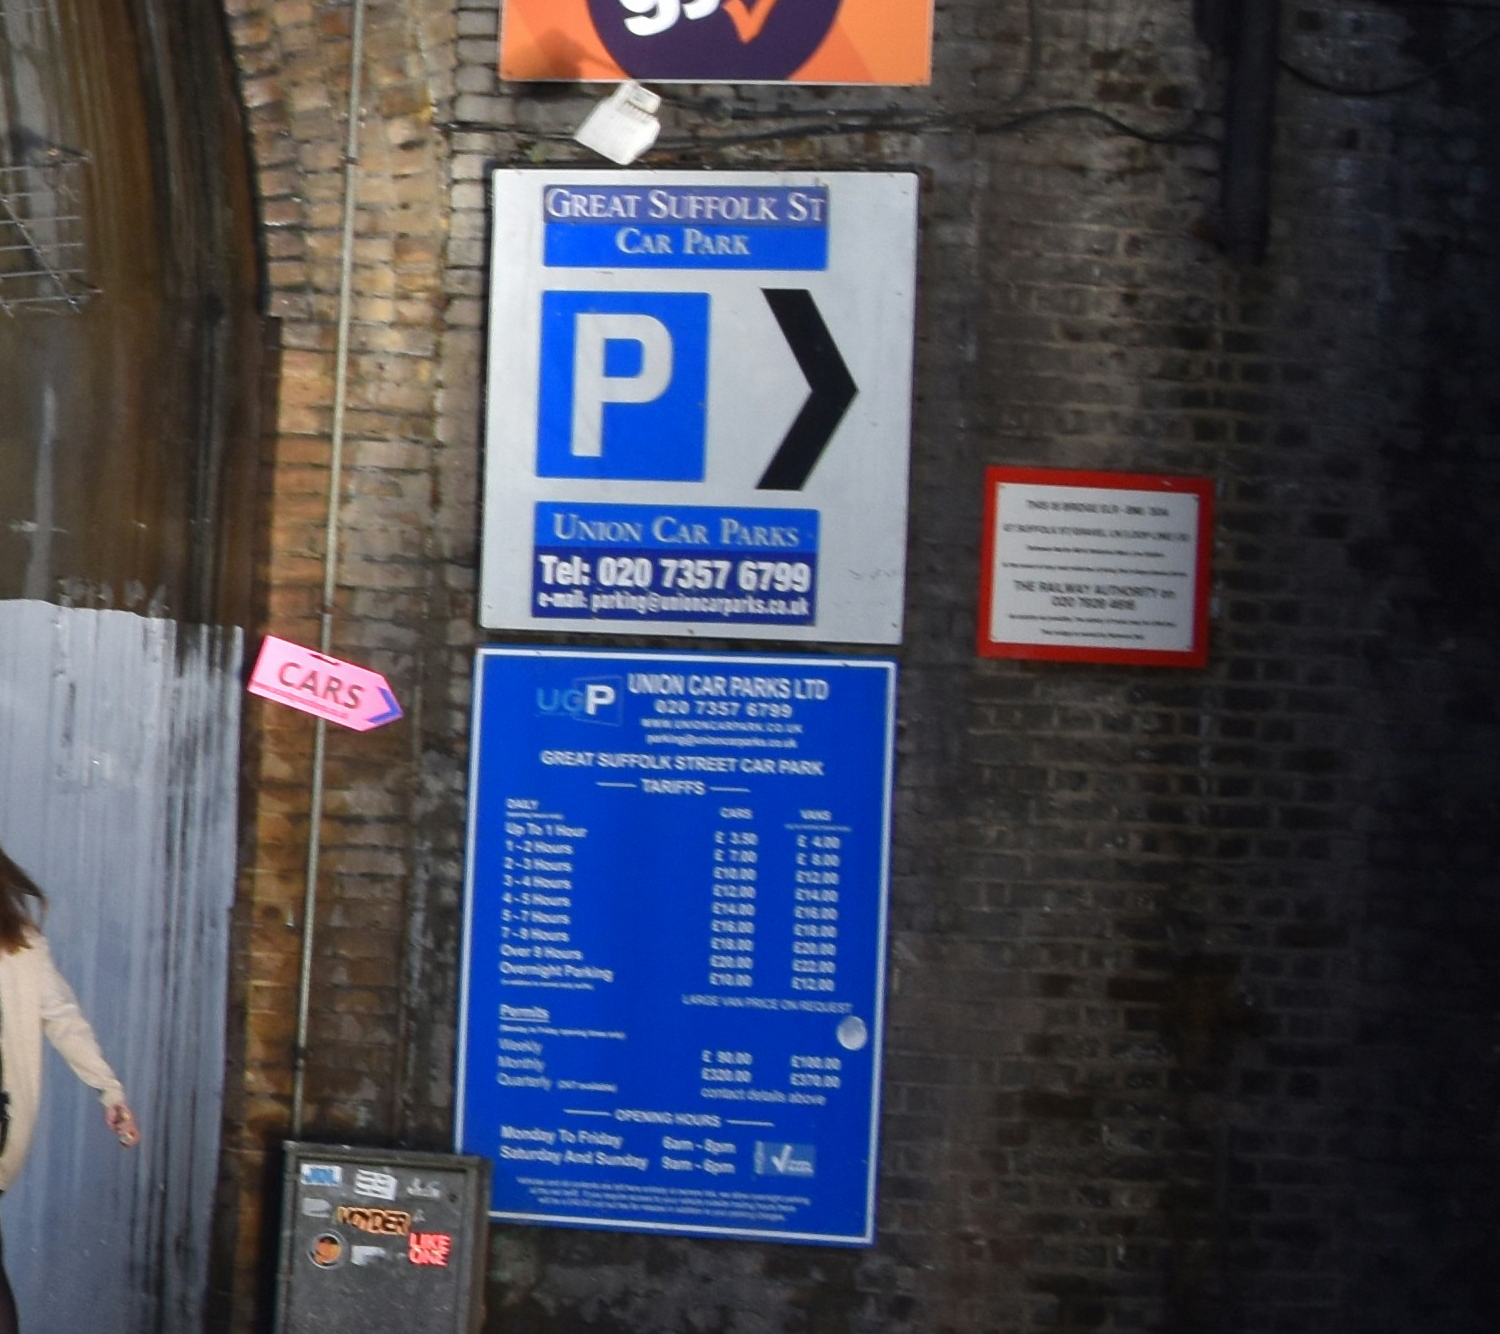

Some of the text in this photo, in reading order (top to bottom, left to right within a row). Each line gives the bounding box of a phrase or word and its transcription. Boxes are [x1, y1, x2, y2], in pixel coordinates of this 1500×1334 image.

[545, 188, 827, 222] GREAT SUFFOLK ST
[615, 227, 750, 255] CAR PARK
[571, 312, 673, 458] P
[552, 512, 800, 548] UNION CAR PARKS
[538, 554, 811, 593] Tel: 020 7357 6799
[1039, 581, 1090, 594] RAILWAY
[1094, 584, 1158, 598] AUTHORITY
[591, 591, 809, 616] parking@unioncarparks.co.uk
[277, 661, 365, 710] CARS
[628, 673, 685, 696] UNION
[689, 674, 726, 697] CAR
[730, 676, 791, 699] PARKS
[795, 679, 829, 700] LTD
[655, 700, 793, 718] 020 7357 6799
[540, 750, 824, 775] GREAT SUFFOLK STREET CAR PARK
[641, 779, 706, 795] TARIFFS
[719, 807, 753, 819] CARS
[800, 810, 833, 822] VANS
[506, 822, 525, 837] Up
[526, 823, 543, 836] To
[555, 825, 588, 837] Hour
[533, 842, 574, 856] Hours
[533, 859, 573, 873] Hours
[713, 866, 757, 881] £10.00
[532, 876, 572, 890] Hours
[531, 894, 571, 908] Hours
[531, 911, 571, 925] Hours
[530, 928, 570, 942] Hours
[500, 944, 531, 958] Over
[544, 947, 583, 960] Hours
[500, 961, 614, 983] Overnight Parking
[500, 1004, 549, 1018] Permits
[682, 994, 853, 1014] LARGE VAN PRICE ON REQUEST
[499, 1038, 542, 1055] Weekly
[498, 1055, 545, 1073] Monthly
[497, 1072, 551, 1090] Quarterly
[701, 1087, 826, 1106] contact details above
[615, 1109, 721, 1128] OPENING HOURS
[500, 1124, 624, 1149] Monday To Friday
[500, 1145, 650, 1171] Saturday And Sunday
